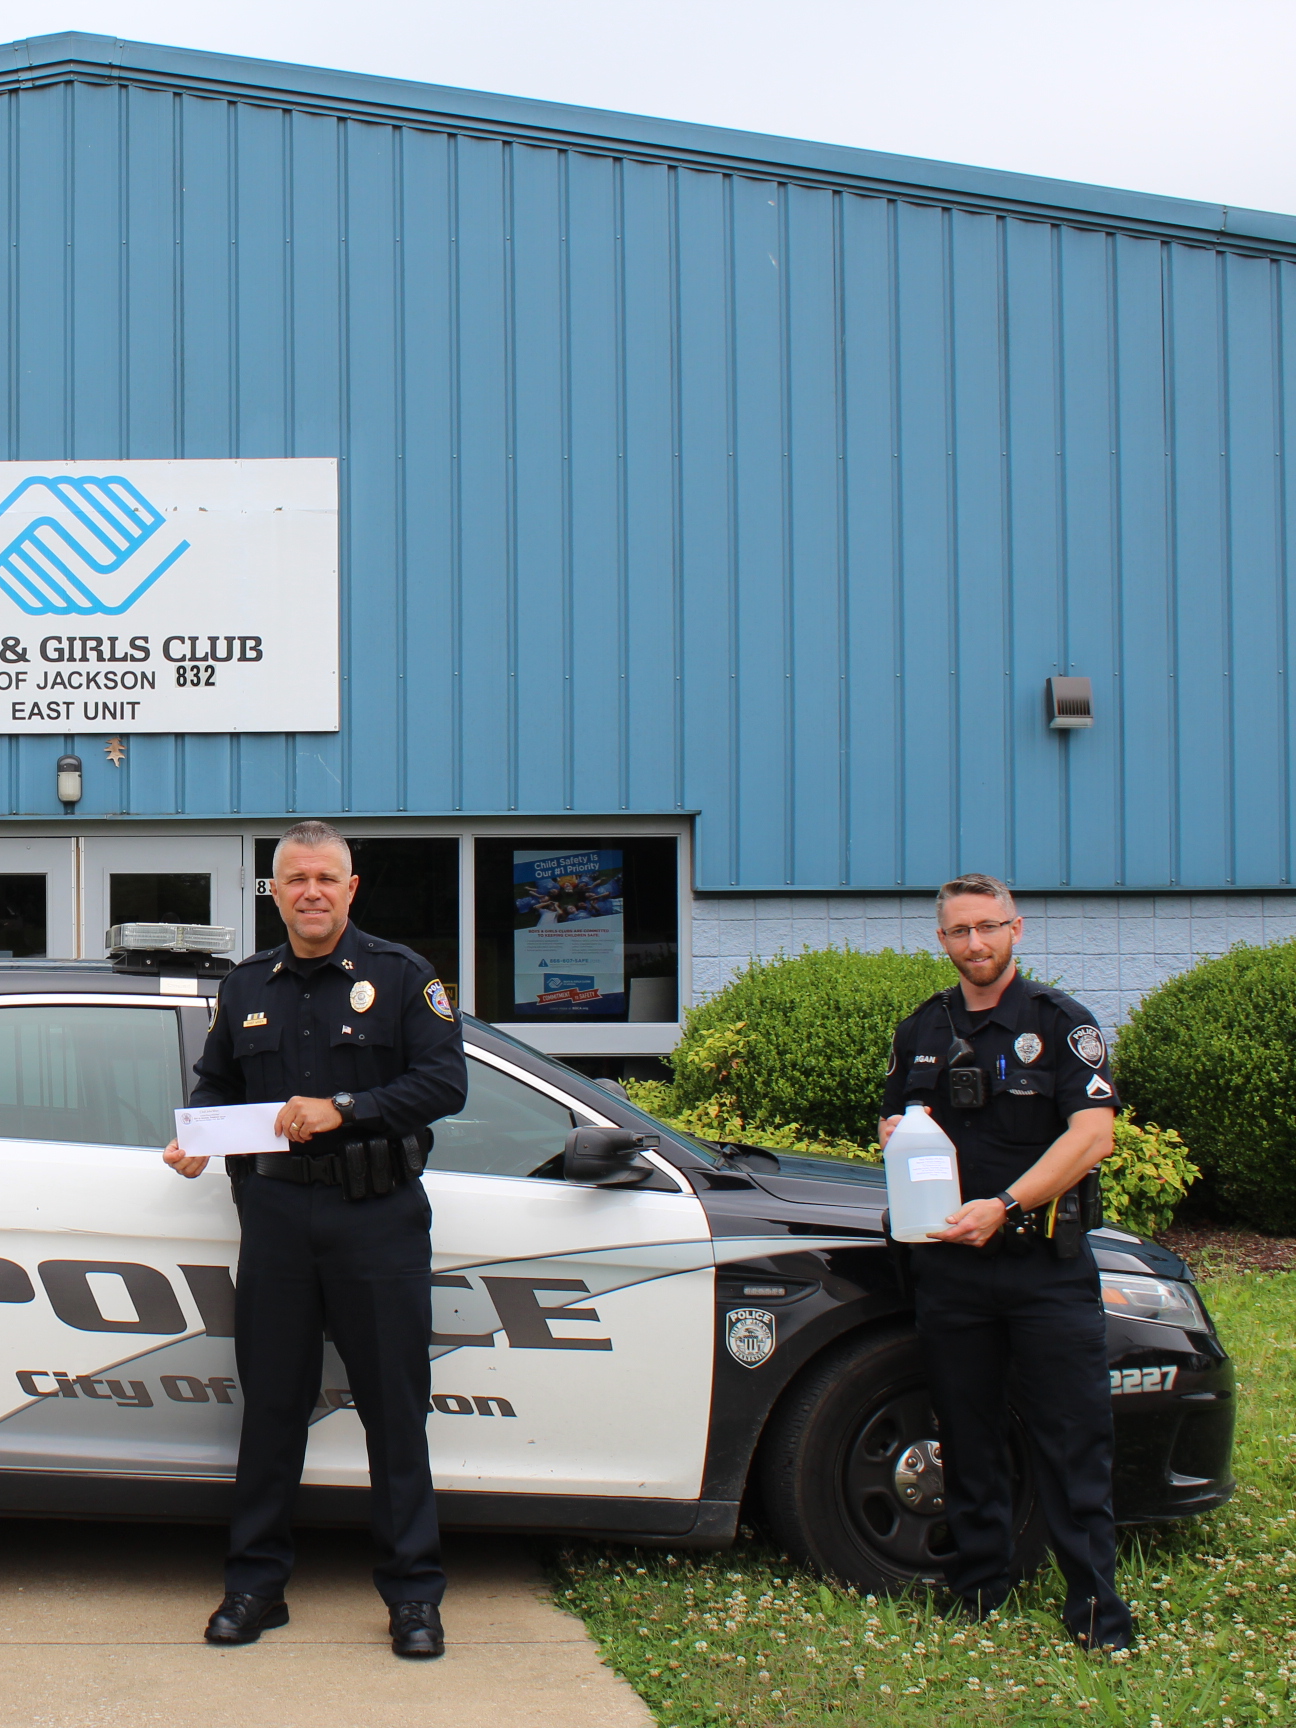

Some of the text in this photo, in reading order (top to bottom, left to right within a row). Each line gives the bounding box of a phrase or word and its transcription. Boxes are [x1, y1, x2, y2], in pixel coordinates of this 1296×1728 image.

[0, 636, 30, 663] &
[39, 636, 151, 663] GIRLS
[162, 635, 263, 663] CLUB
[36, 670, 155, 690] JACKSON
[175, 665, 216, 687] 832
[11, 701, 141, 720] EAST UNIT
[534, 860, 557, 870] Child
[559, 855, 587, 866] Safety
[535, 862, 600, 878] Our #1 Priority
[427, 982, 442, 995] POL
[1072, 1028, 1098, 1040] POLICE
[730, 1310, 772, 1324] POLICE
[15, 1370, 237, 1408] City Of
[1109, 1365, 1178, 1395] 2227
